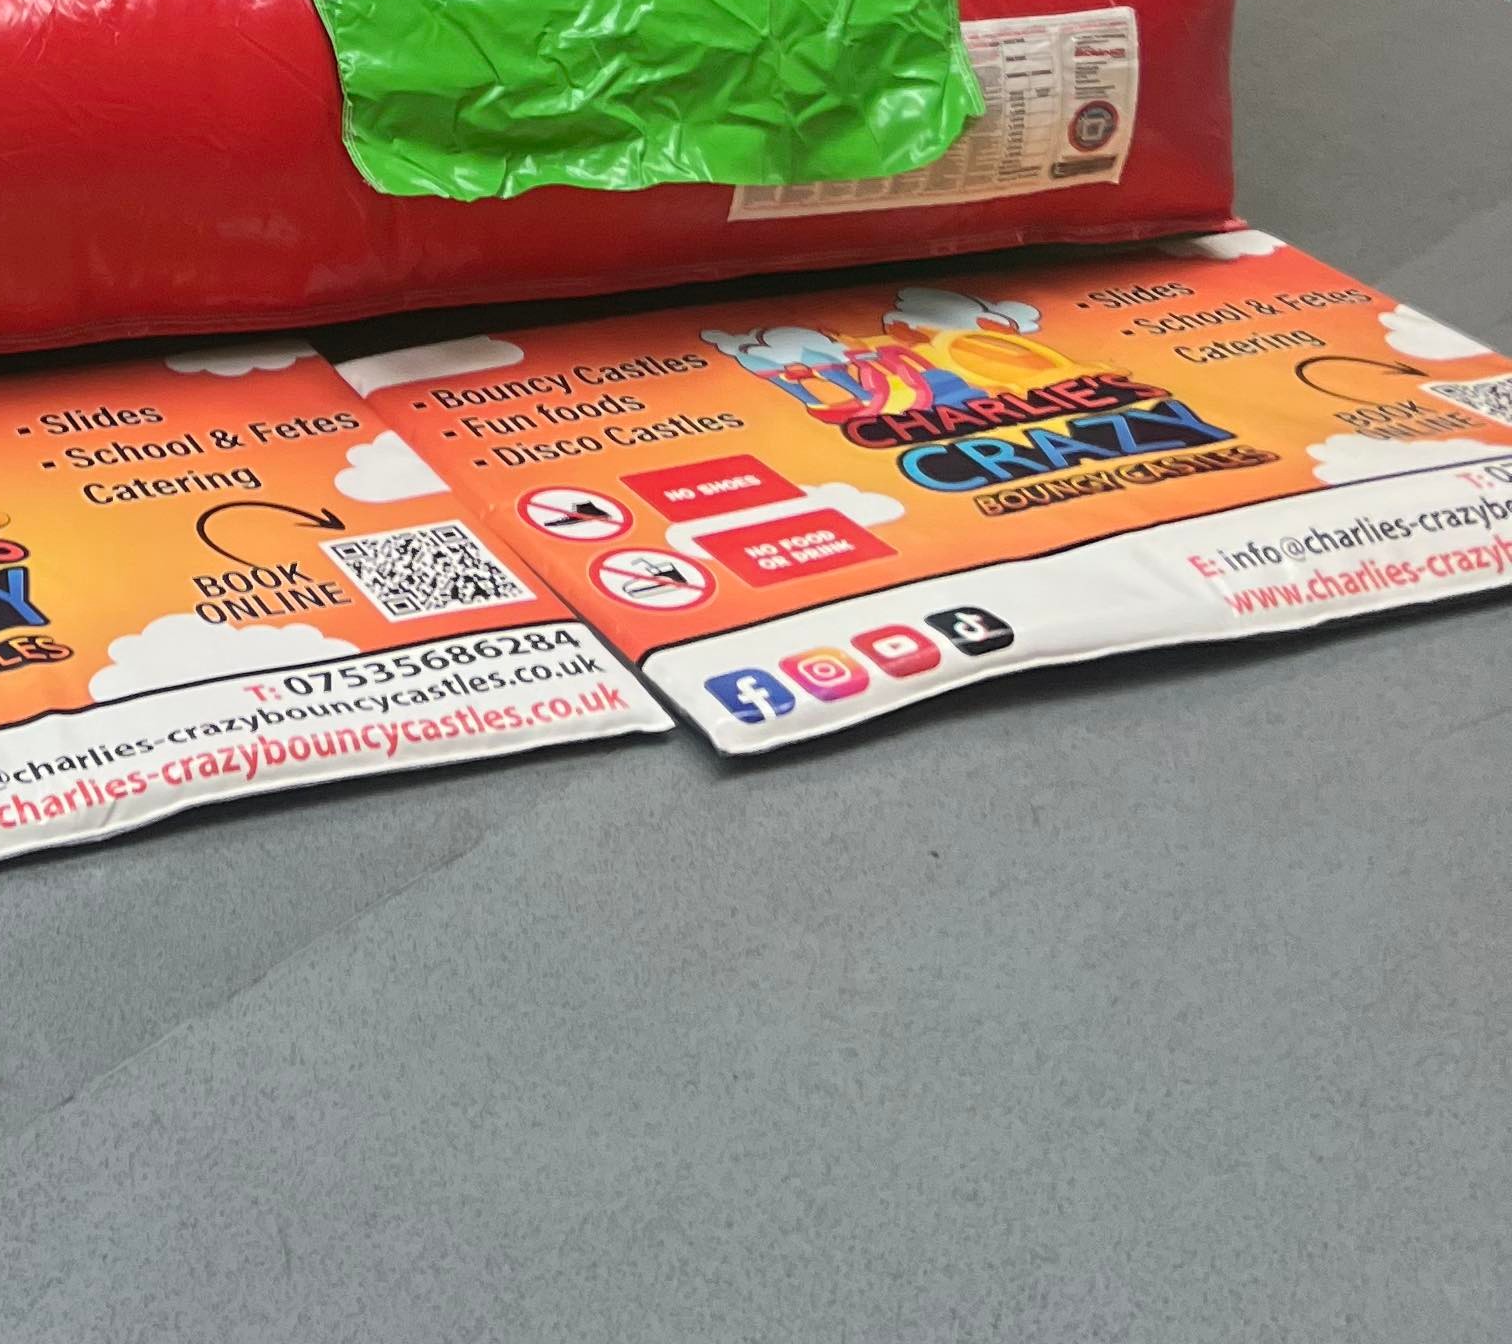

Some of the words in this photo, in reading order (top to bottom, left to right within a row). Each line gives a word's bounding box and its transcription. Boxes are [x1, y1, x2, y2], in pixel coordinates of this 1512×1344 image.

[1088, 280, 1196, 310] Slides
[1134, 302, 1250, 336] School
[1245, 298, 1280, 316] &
[1276, 288, 1374, 313] Fetes
[1173, 328, 1327, 364] Catering
[431, 372, 574, 410] Bouncy
[574, 351, 709, 386] Castles
[40, 404, 164, 435] Slides
[460, 409, 538, 439] Fun
[537, 392, 646, 425] foods
[846, 372, 1170, 447] CHARLIE'S
[65, 434, 204, 469] School
[210, 429, 244, 450] &
[249, 412, 360, 445] Fetes
[492, 435, 603, 468] Disco
[604, 411, 745, 447] Castles
[900, 400, 1236, 492] CRAZY
[83, 467, 261, 505] Catering
[664, 487, 696, 503] NO
[697, 474, 761, 496] SHOES
[975, 470, 1125, 515] BOUNCY
[1117, 446, 1280, 485] CASTLES
[744, 543, 777, 559] NO
[779, 530, 836, 552] FOOD
[757, 555, 792, 570] OR
[791, 539, 856, 565] DRINK
[1189, 553, 1226, 578] E:
[193, 562, 313, 598] BOOK
[195, 581, 352, 625] ONLINE
[244, 684, 282, 704] T:
[285, 629, 581, 695] 07535686284
